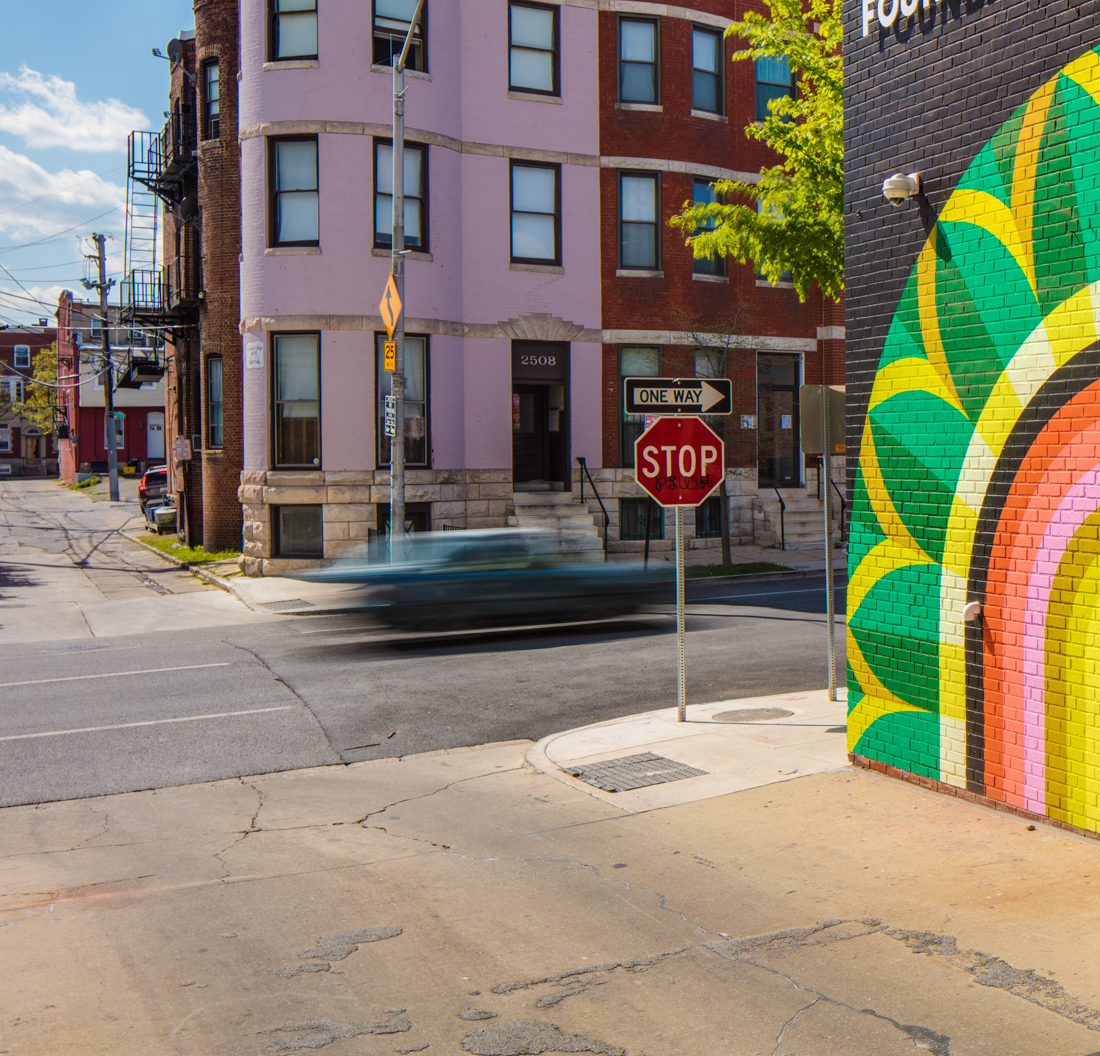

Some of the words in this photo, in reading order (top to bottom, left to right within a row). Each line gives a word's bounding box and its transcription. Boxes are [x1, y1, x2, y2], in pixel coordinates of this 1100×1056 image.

[385, 345, 395, 359] 25
[521, 355, 556, 365] 2508
[639, 390, 668, 403] ONE
[673, 390, 702, 403] WAY
[642, 445, 717, 478] STOP
